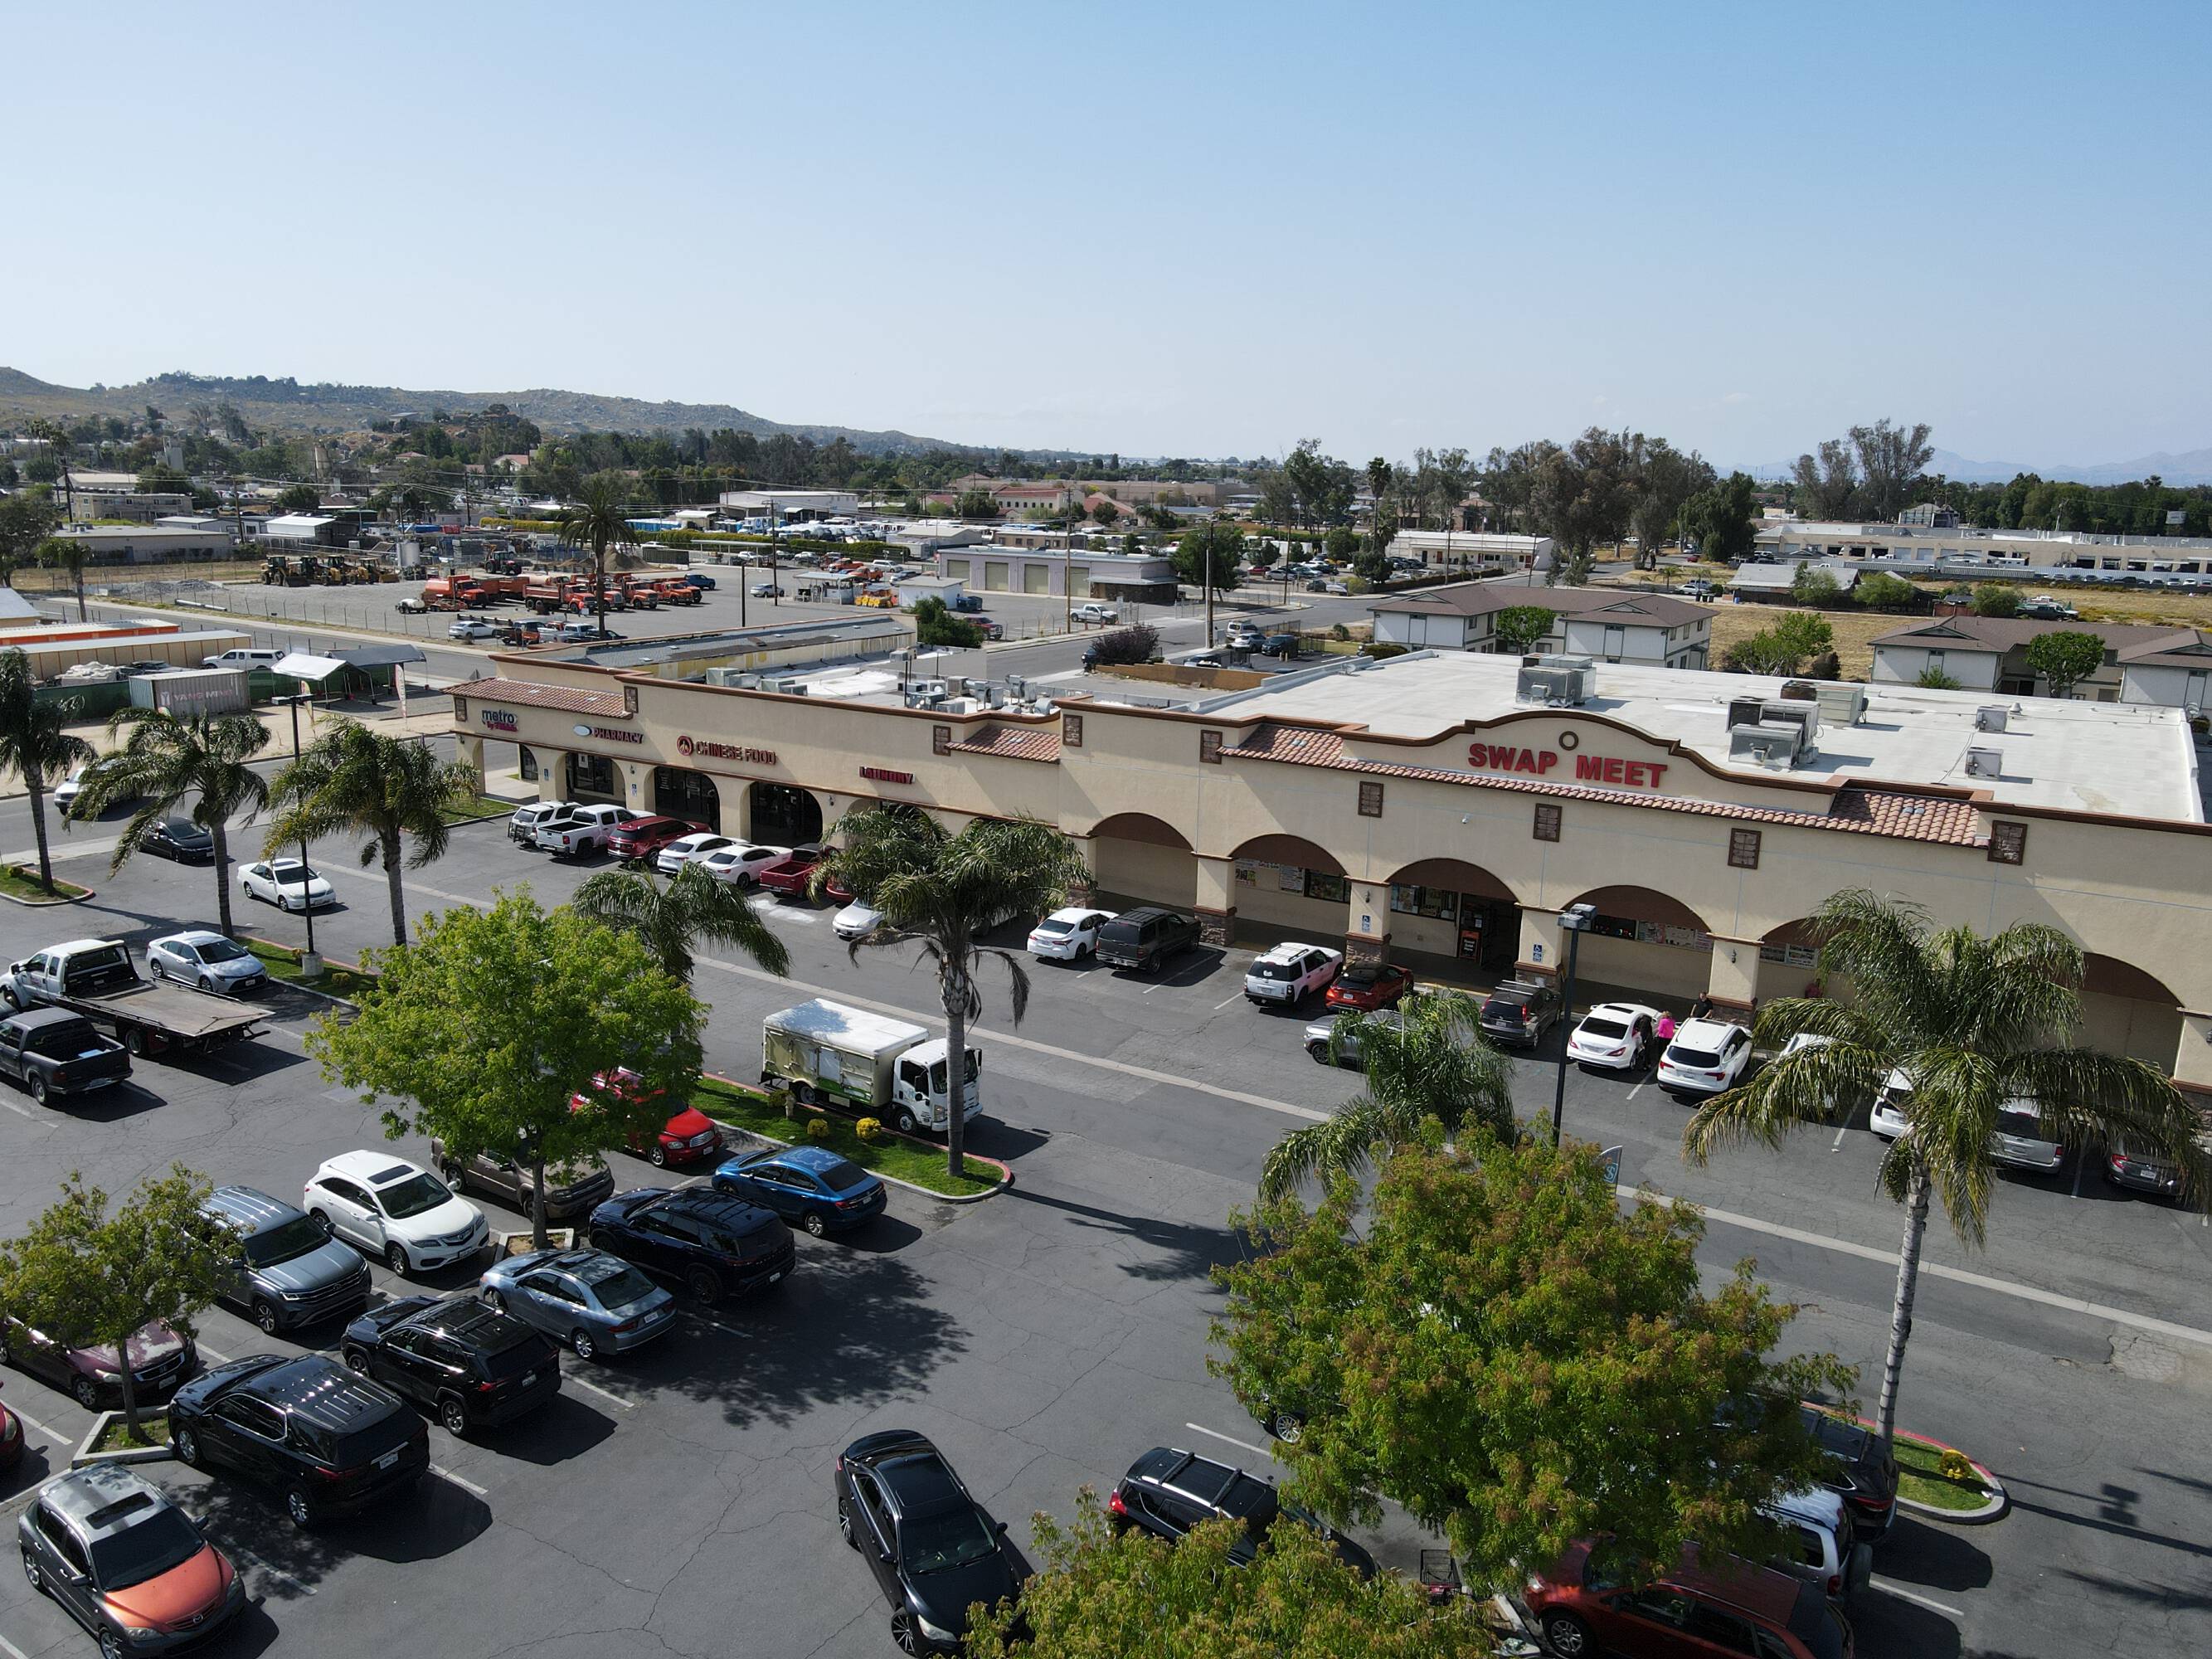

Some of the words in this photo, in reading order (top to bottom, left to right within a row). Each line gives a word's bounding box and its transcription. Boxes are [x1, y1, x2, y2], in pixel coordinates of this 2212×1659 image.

[481, 709, 516, 724] metro
[592, 727, 644, 744] PHARMACY
[696, 741, 743, 761] CHINESE
[744, 747, 776, 765] FOOD
[1467, 742, 1558, 775] SWAP
[1575, 755, 1668, 788] MEET
